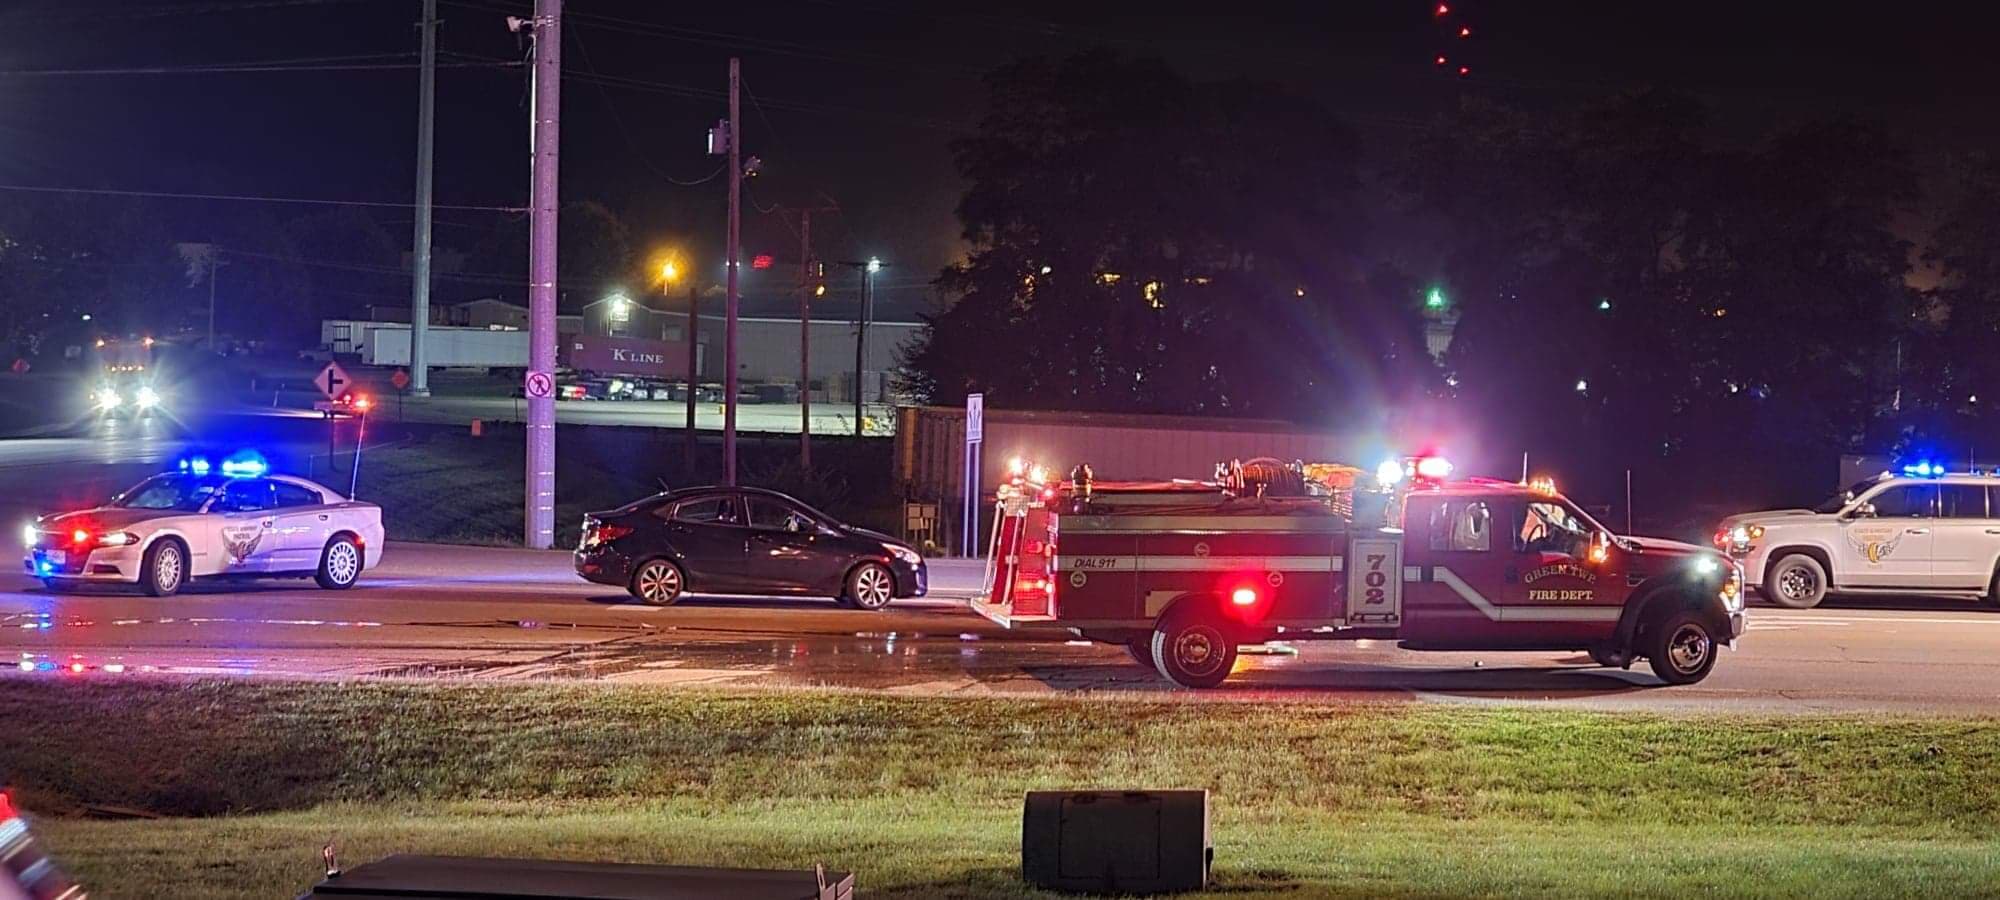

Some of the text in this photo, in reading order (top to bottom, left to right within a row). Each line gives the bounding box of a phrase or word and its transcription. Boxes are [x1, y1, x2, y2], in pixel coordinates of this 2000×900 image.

[611, 348, 664, 363] K LINE
[1074, 558, 1116, 568] DIAL 911
[1365, 554, 1386, 605] 702
[1524, 564, 1567, 583] GREEN
[1529, 590, 1594, 600] FIRE DEPT.
